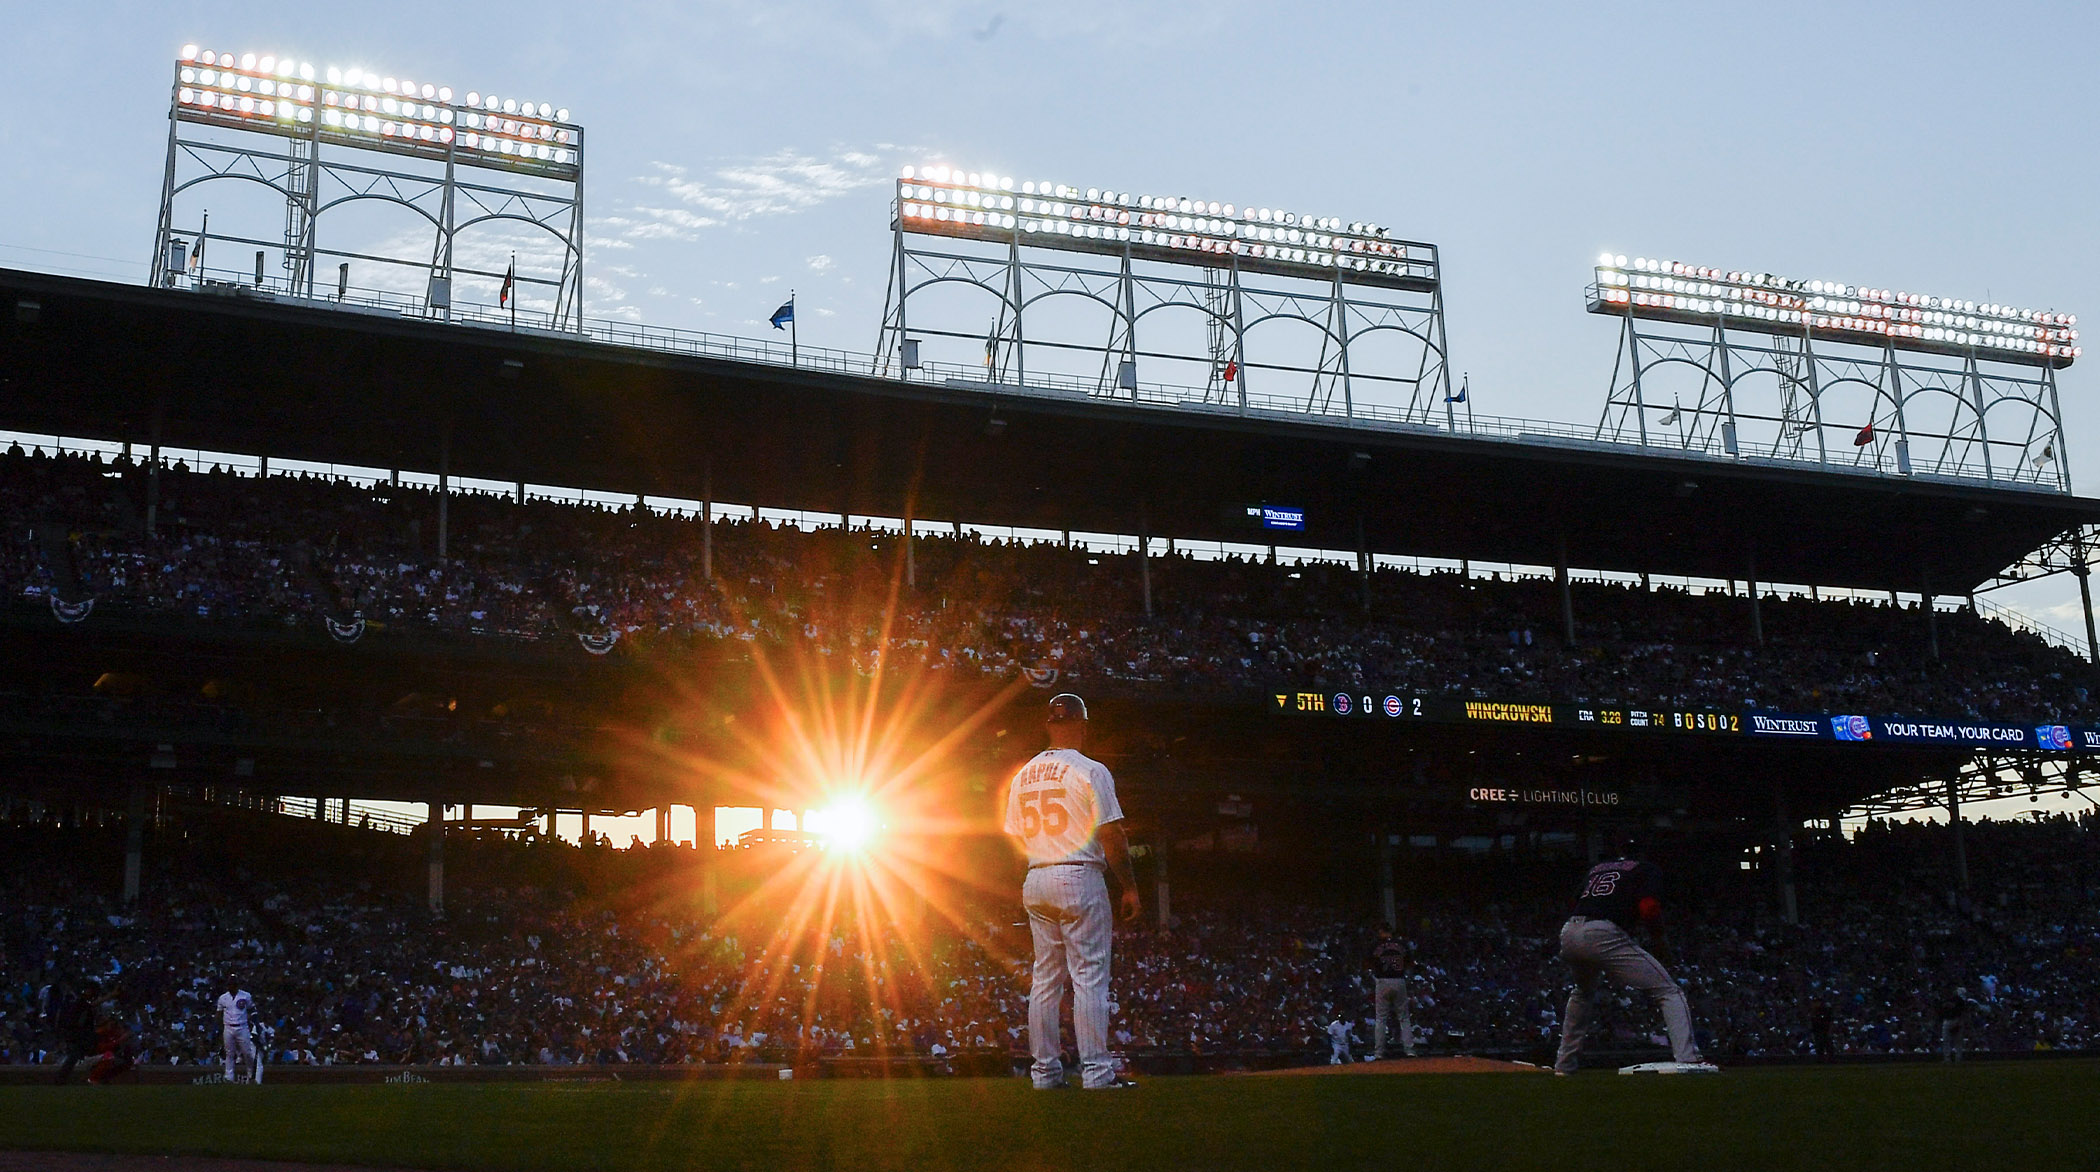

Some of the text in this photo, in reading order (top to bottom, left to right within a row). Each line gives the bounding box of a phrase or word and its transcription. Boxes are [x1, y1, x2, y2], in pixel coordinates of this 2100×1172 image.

[1264, 509, 1303, 520] WINTRUST
[1297, 692, 1325, 711] 5TH
[1363, 696, 1373, 713] 0
[1412, 698, 1422, 716] 2
[1465, 702, 1552, 722] WINCKOWSKI
[1579, 710, 1594, 721] ERA
[1753, 716, 1818, 732] WINTRUST
[1884, 723, 2024, 741] YOUR TEAM, YOUR CARD
[1020, 762, 1070, 787] NAPOLI
[1470, 788, 1619, 805] CREE LIGHTING CLUB
[1018, 788, 1069, 838] 55
